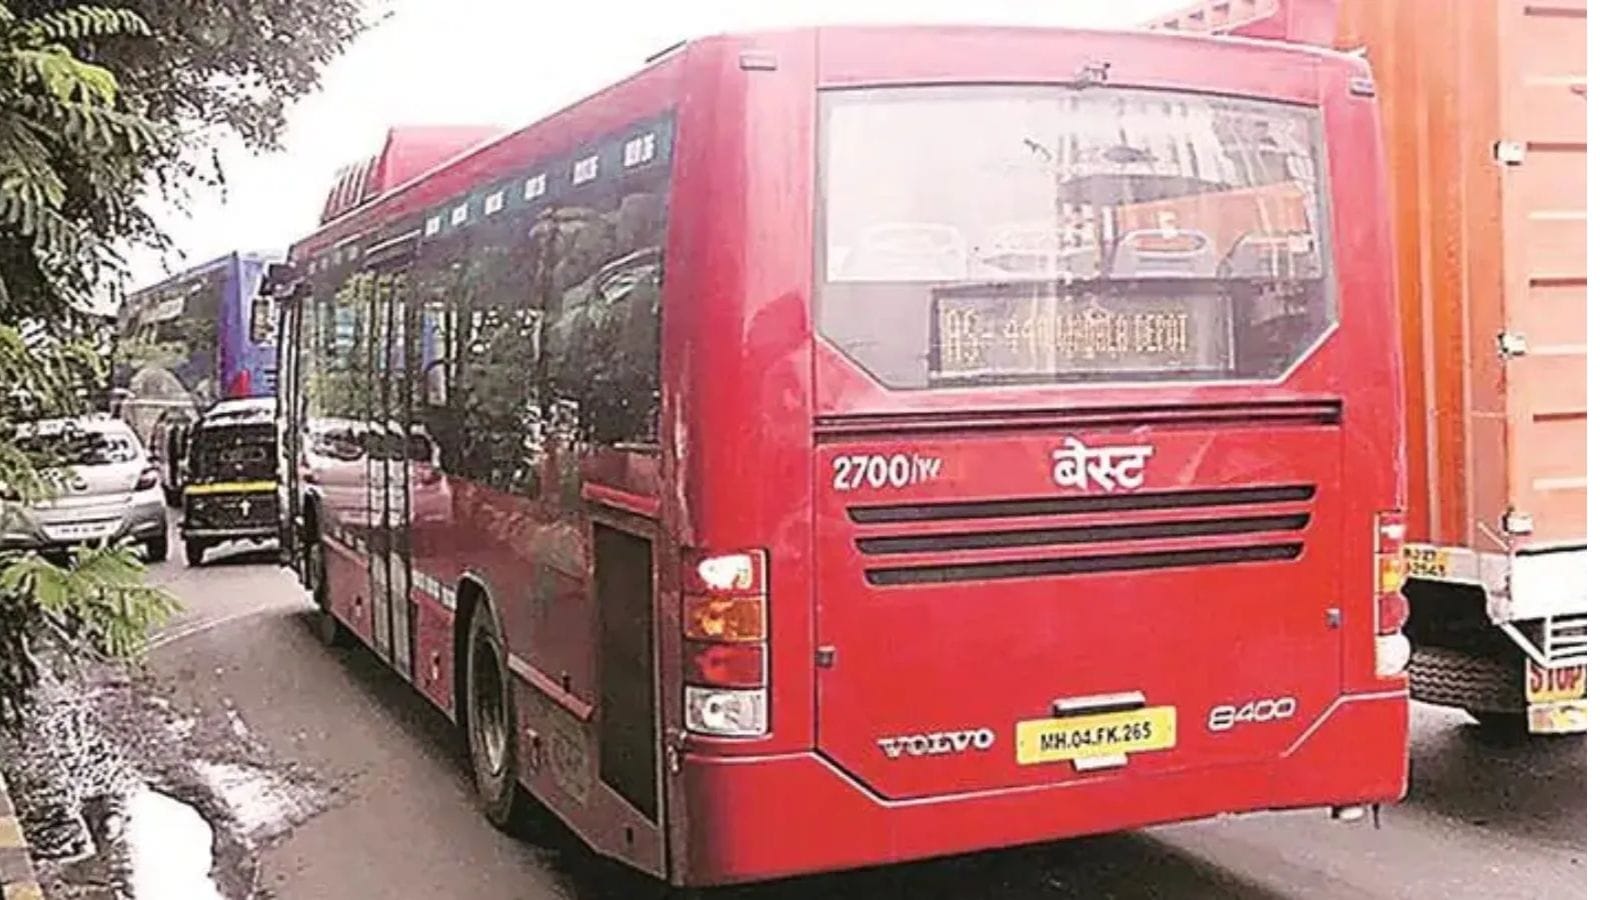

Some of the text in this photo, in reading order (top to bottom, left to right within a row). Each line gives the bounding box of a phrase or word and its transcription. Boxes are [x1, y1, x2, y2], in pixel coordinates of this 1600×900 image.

[1053, 438, 1153, 491] बेस्ट
[1530, 664, 1583, 693] STOP
[1208, 696, 1298, 731] 8400
[878, 727, 996, 758] VOLVO
